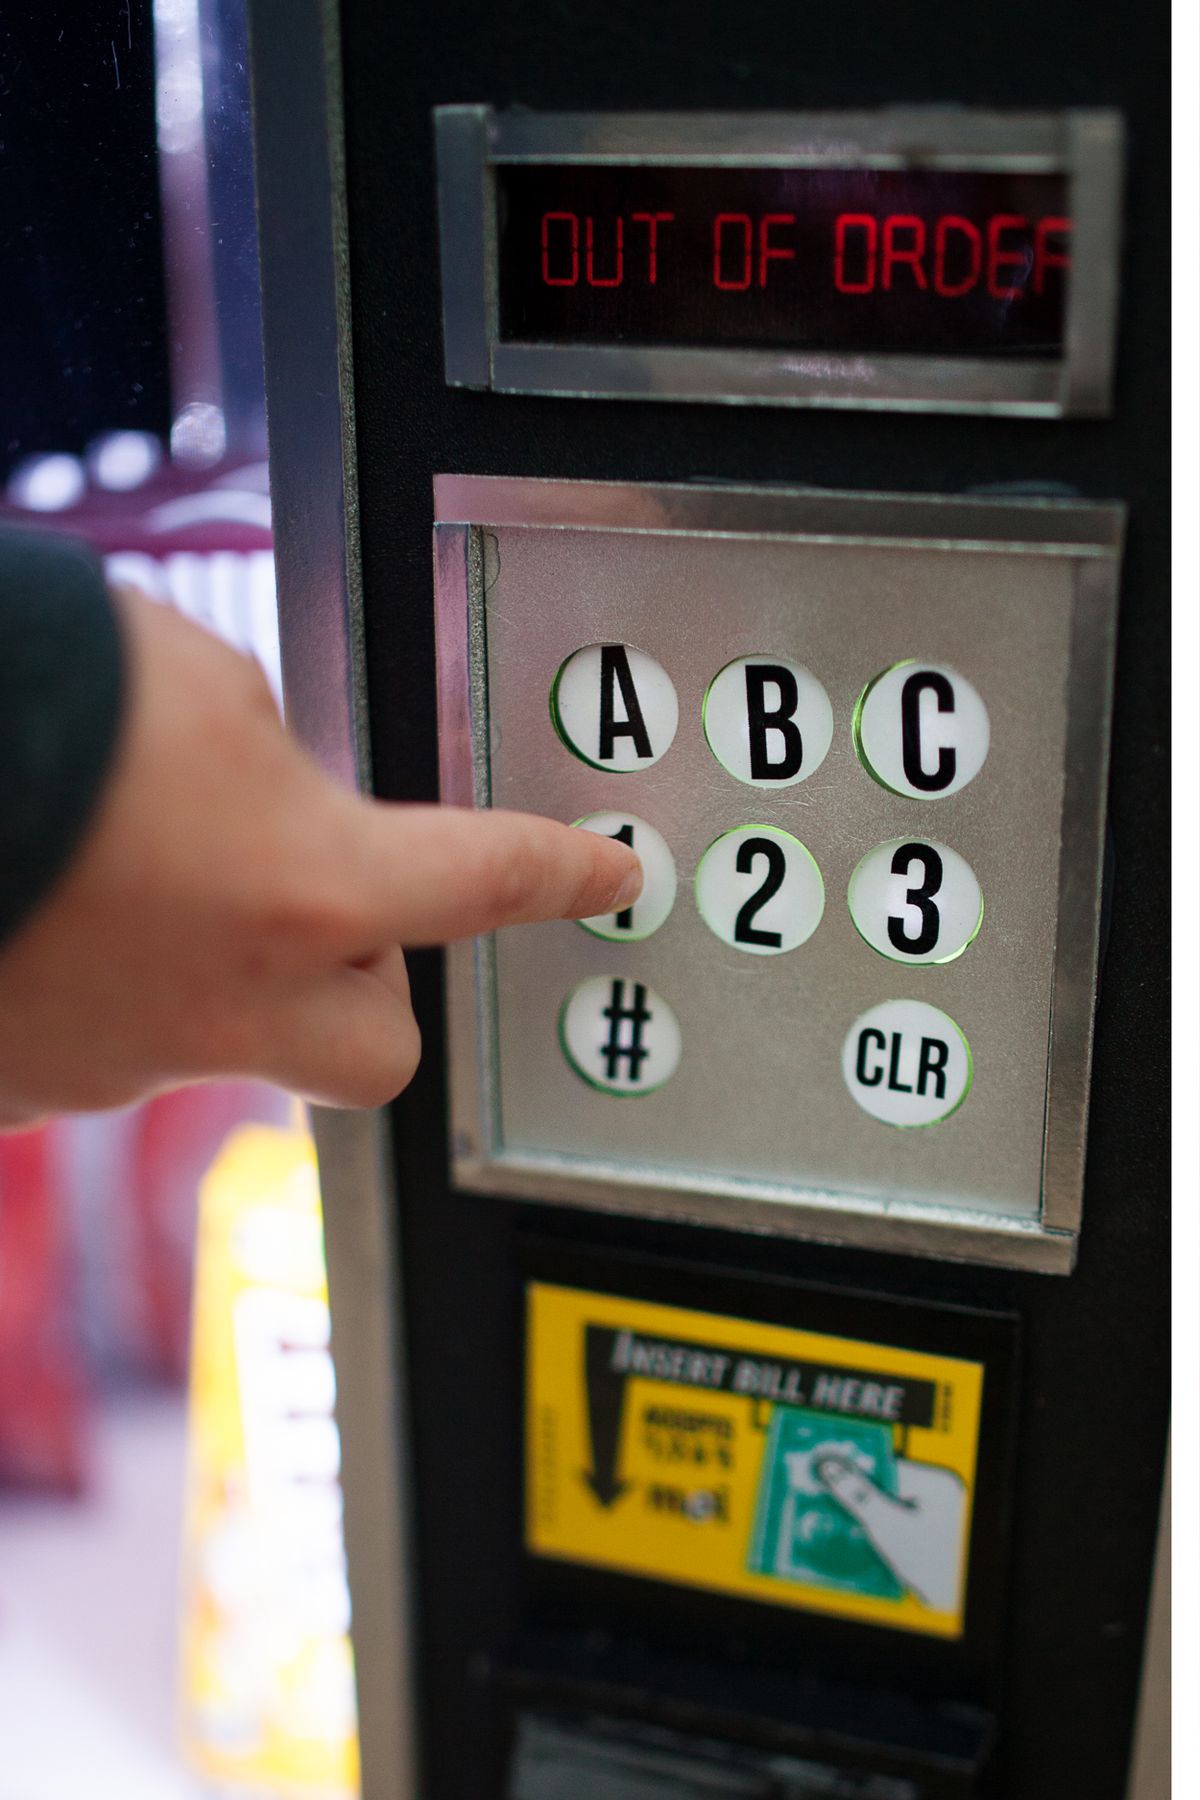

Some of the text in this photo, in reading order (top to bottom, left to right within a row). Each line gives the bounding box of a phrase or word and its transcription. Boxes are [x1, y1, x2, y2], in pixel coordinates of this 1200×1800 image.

[542, 212, 674, 287] OUT
[713, 213, 795, 290] OF
[599, 645, 653, 760] A
[745, 664, 803, 781] B
[901, 670, 956, 792] C
[734, 837, 786, 948] 2
[887, 842, 943, 955] 3
[599, 979, 652, 1082] #
[855, 1027, 949, 1099] CLR
[611, 1328, 730, 1389] INSERT
[732, 1359, 804, 1403] BILL
[813, 1374, 906, 1420] HERE
